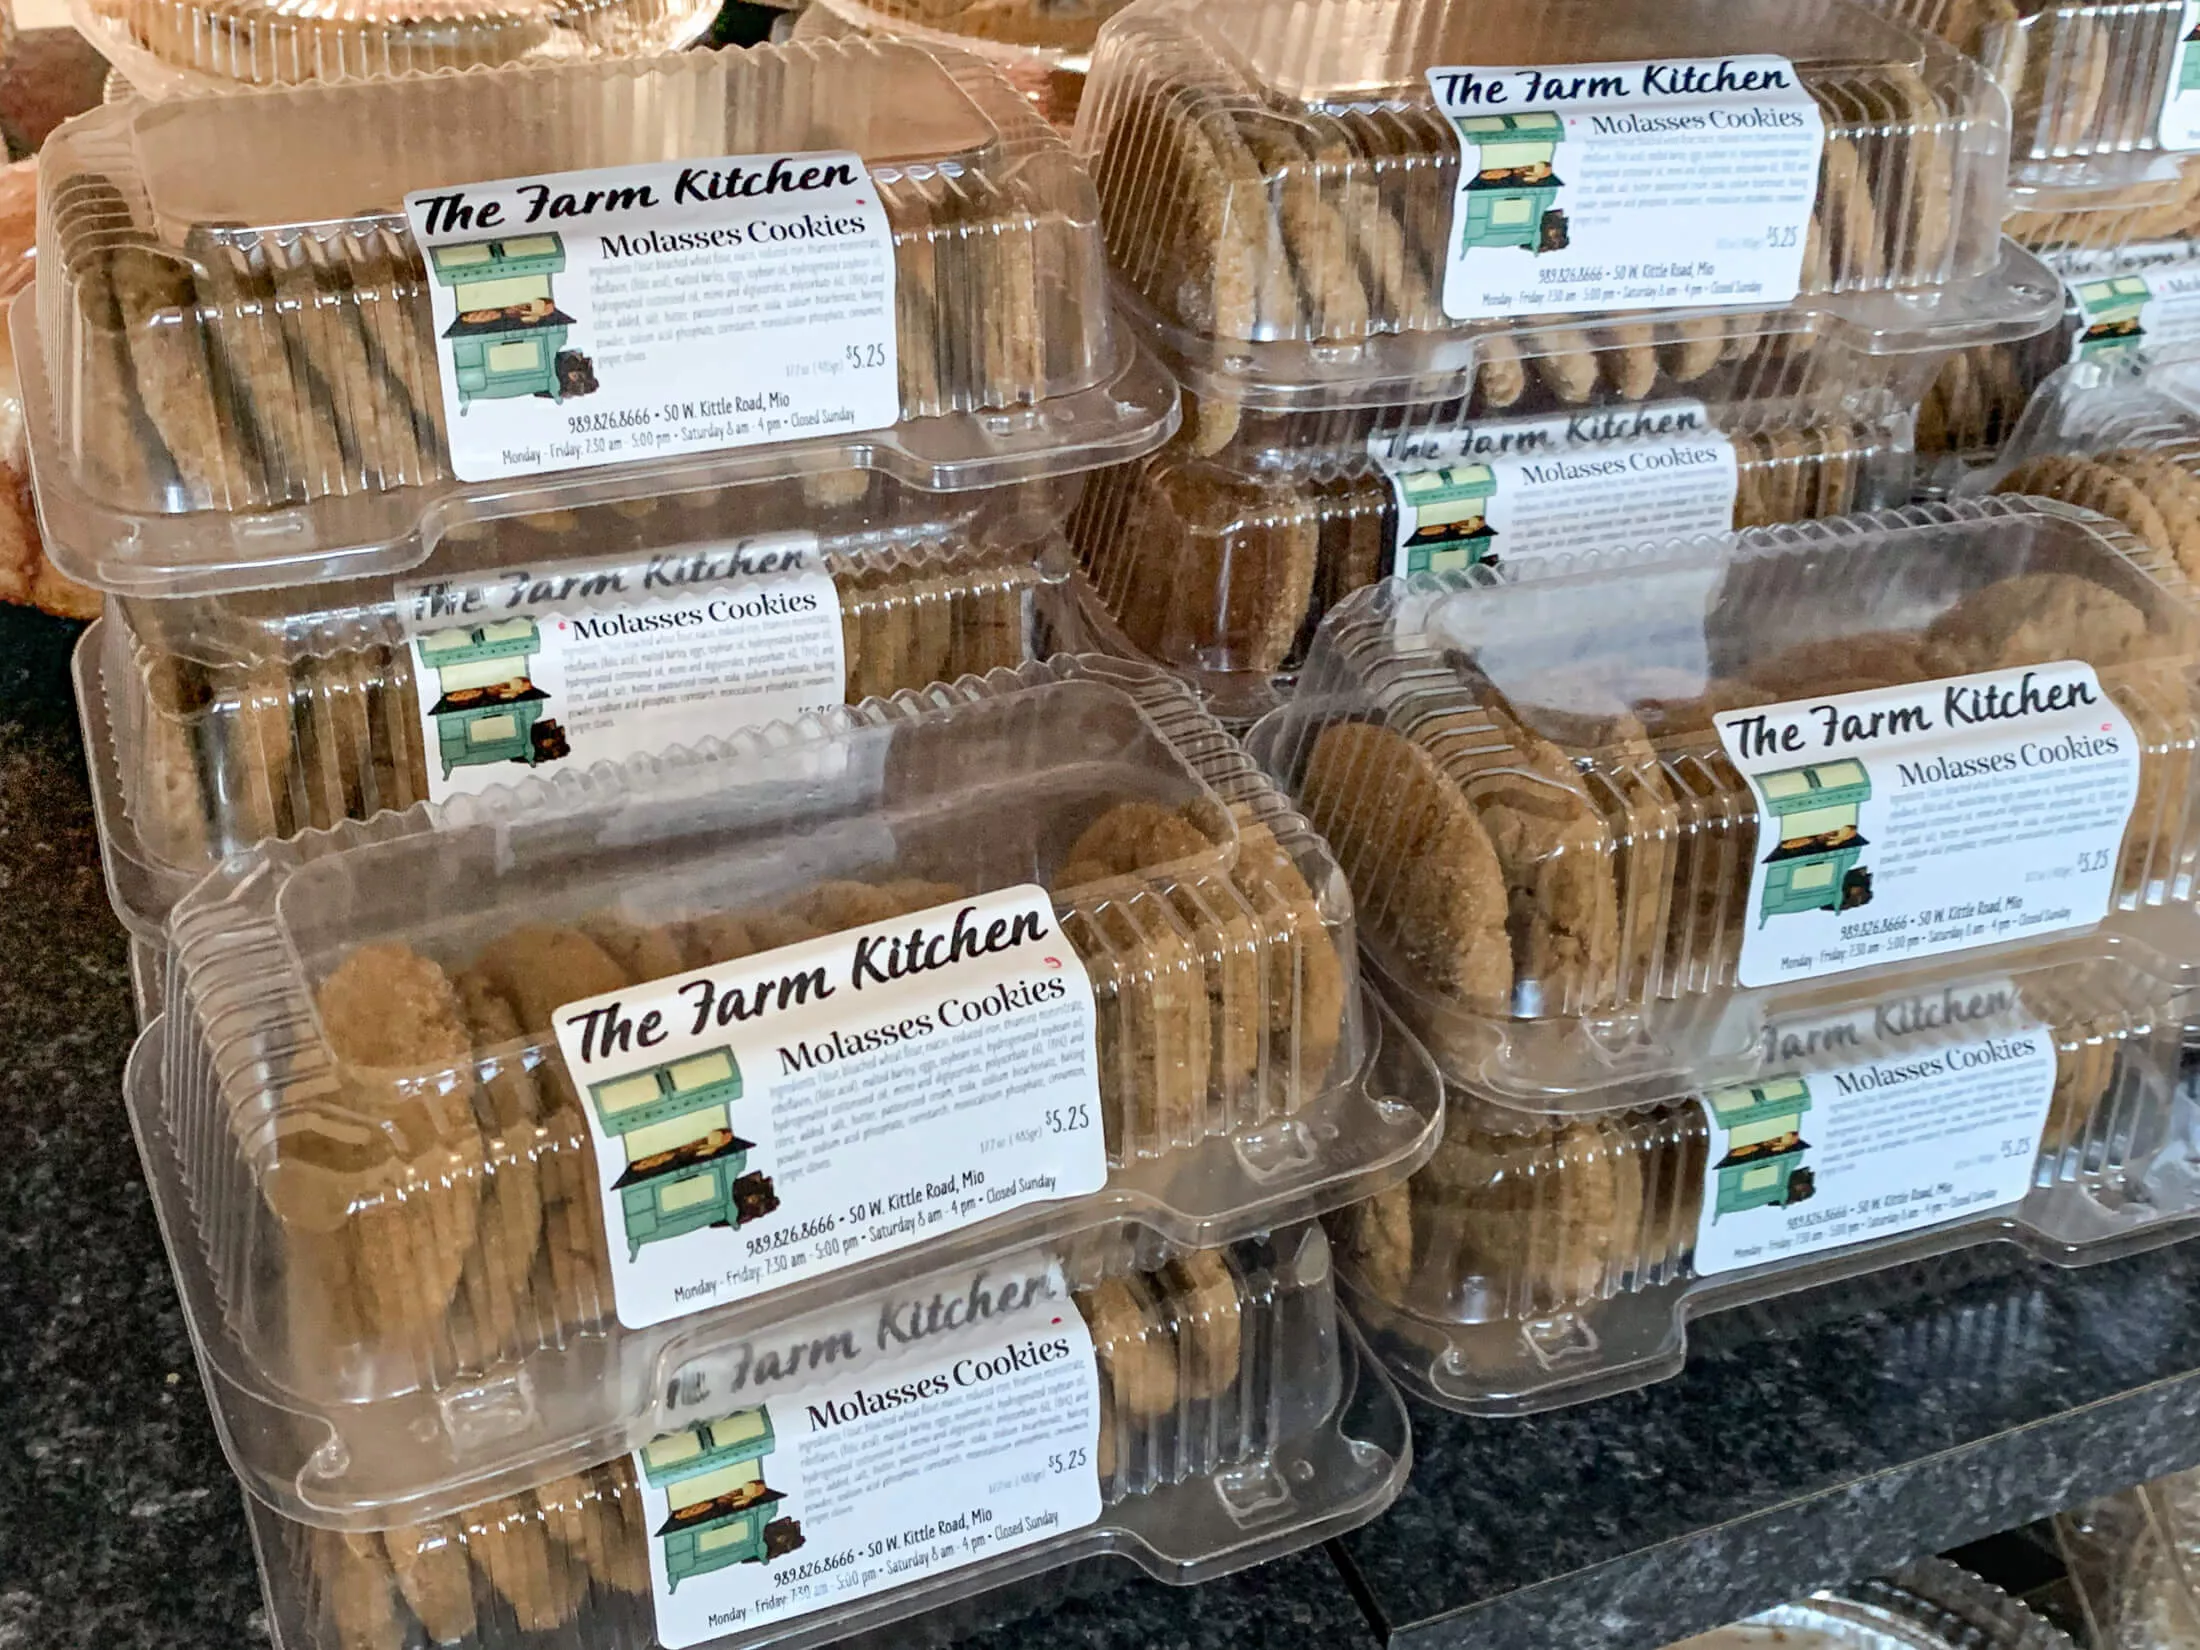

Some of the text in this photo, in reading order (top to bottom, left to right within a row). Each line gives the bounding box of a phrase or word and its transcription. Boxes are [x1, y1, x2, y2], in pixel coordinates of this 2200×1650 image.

[1437, 60, 1791, 106] The Farm Kitchen
[1592, 106, 1804, 136] Molasses Cookies
[415, 157, 858, 235] The Farm Kitchen
[600, 213, 865, 260] Molasses Cookies
[846, 342, 885, 369] $5.25
[503, 445, 541, 465] Monday
[681, 421, 724, 442] Saturday
[735, 421, 749, 435] am
[767, 417, 781, 436] pm
[791, 409, 820, 428] Closed
[822, 405, 855, 424] Sunday
[568, 407, 650, 434] 989.826.8666
[664, 404, 679, 422] 50
[700, 397, 733, 417] Kittle
[736, 392, 766, 413] Road,
[769, 391, 790, 408] Mio
[1565, 407, 1701, 443] Kitchen
[1522, 445, 1718, 487] Molasses Cookies
[499, 571, 629, 608] Farm
[643, 541, 807, 592] Kitchen
[571, 590, 817, 641] Molasses Cookies
[1727, 672, 2098, 759] The Farm Kitchen
[1897, 734, 2120, 788] Molasses Cookies
[566, 907, 1049, 1064] The Farm Kitchen
[778, 1014, 934, 1075] Molasses
[938, 975, 1067, 1027] Cookies
[1833, 1037, 2036, 1097] Molasses Cookies
[1045, 1103, 1089, 1134] $5.25
[674, 1279, 717, 1303] Monday
[791, 1252, 807, 1268] am
[843, 1235, 859, 1256] pm
[869, 1214, 916, 1243] Saturday
[918, 1208, 926, 1226] 8
[927, 1207, 943, 1224] am
[951, 1200, 958, 1215] 4
[960, 1197, 976, 1217] pm
[986, 1181, 1017, 1204] Closed
[1018, 1174, 1056, 1194] Sunday
[746, 1214, 835, 1258] 989.826.8666
[850, 1204, 866, 1225] 50
[888, 1188, 923, 1213] Kittle
[926, 1175, 960, 1200] Road,
[962, 1170, 985, 1190] Mio
[877, 1269, 1058, 1350] Kitchen
[806, 1370, 949, 1433] Molasses
[952, 1338, 1071, 1388] Cookies
[1048, 1447, 1087, 1474] $5.25
[708, 1606, 747, 1628] Monday
[862, 1568, 877, 1587] pm
[886, 1551, 930, 1575] Saturday
[940, 1544, 955, 1559] am
[962, 1538, 969, 1553] 4
[971, 1534, 986, 1554] pm
[995, 1519, 1024, 1541] Closed
[1026, 1509, 1059, 1530] Sunday
[774, 1549, 854, 1588] 989.826.8666
[868, 1541, 882, 1558] 50
[903, 1525, 935, 1547] Kittle
[938, 1513, 969, 1536] Road,
[972, 1508, 993, 1526] Mio
